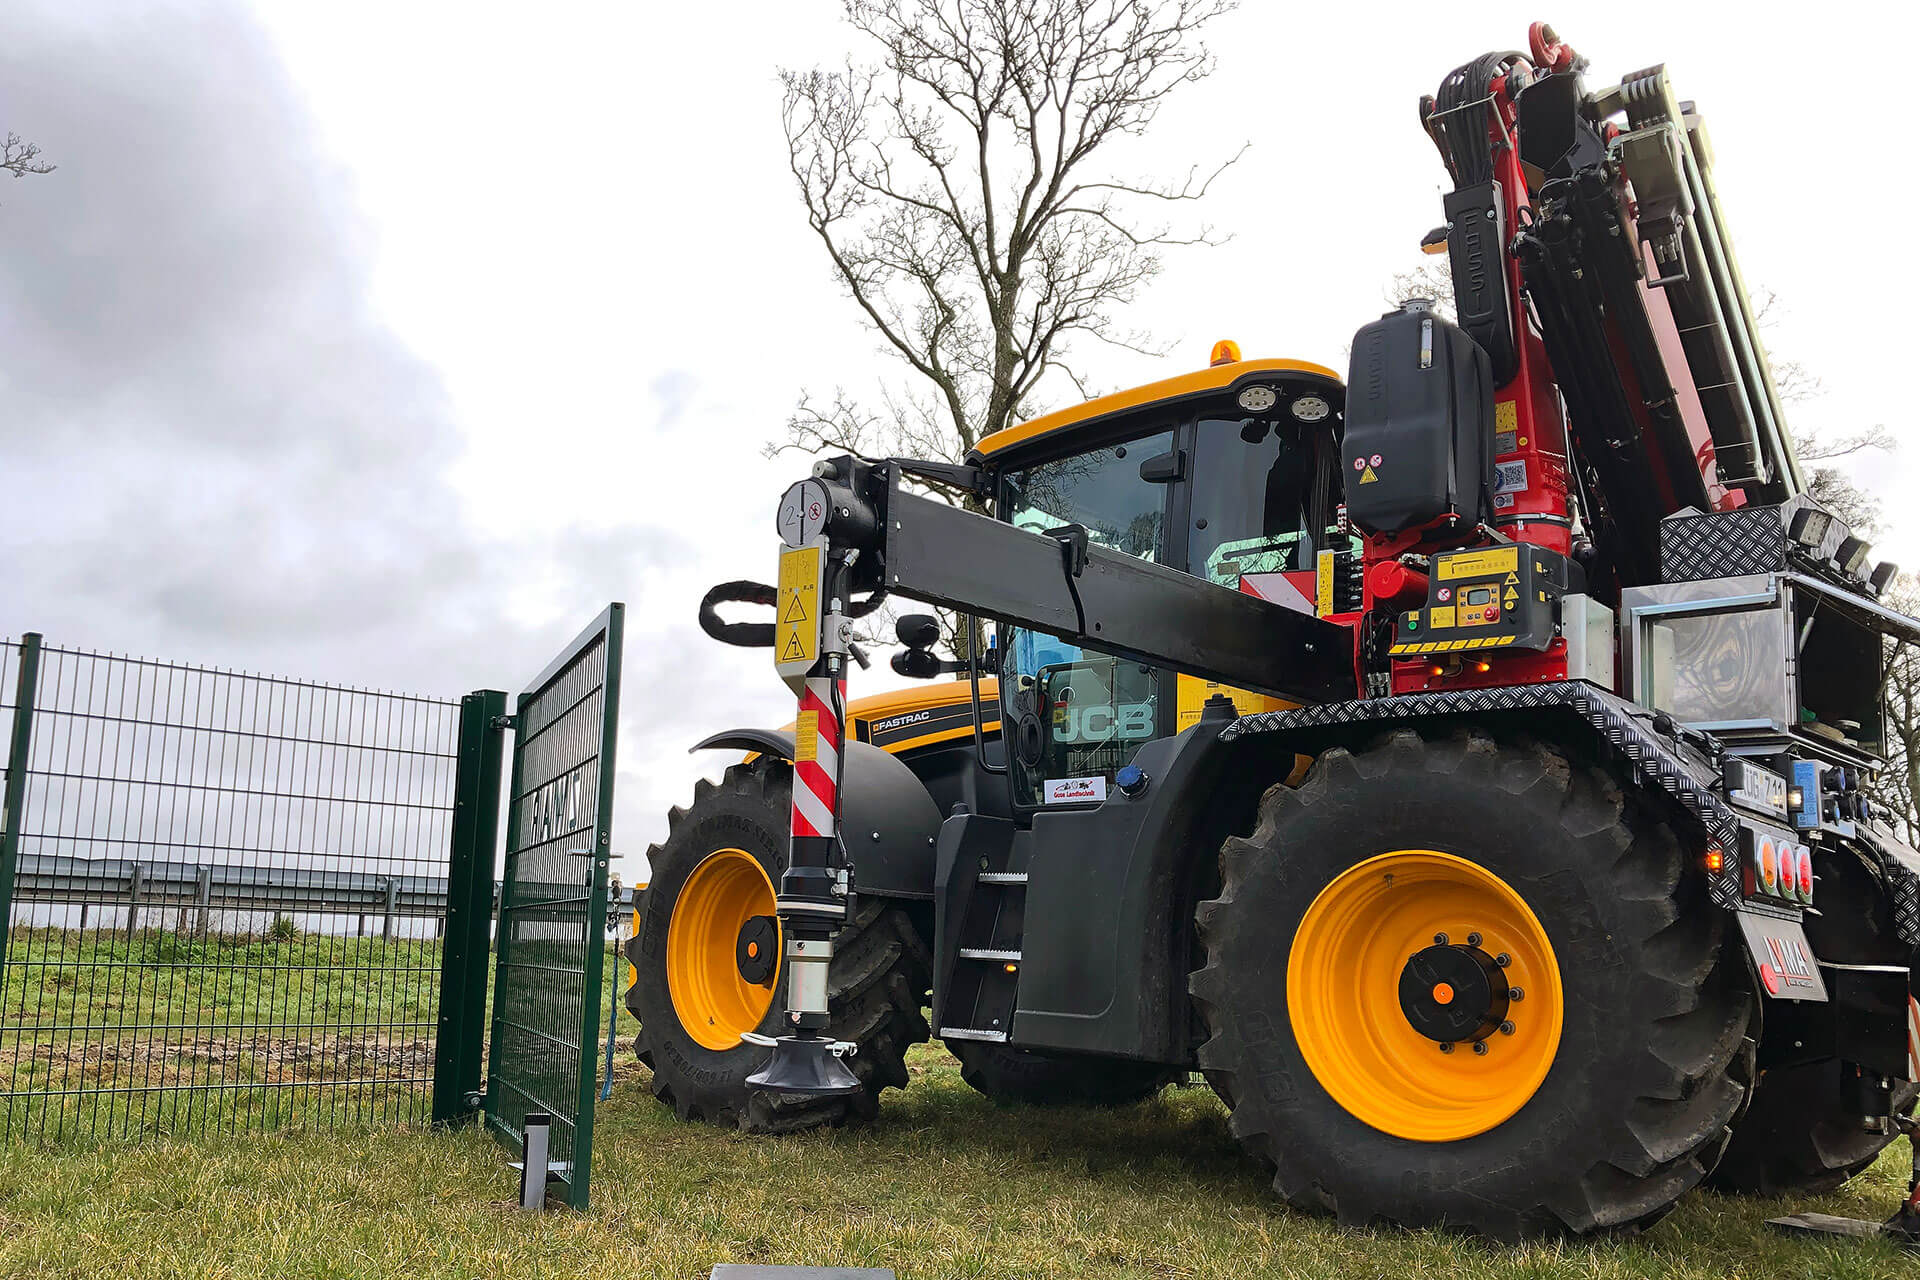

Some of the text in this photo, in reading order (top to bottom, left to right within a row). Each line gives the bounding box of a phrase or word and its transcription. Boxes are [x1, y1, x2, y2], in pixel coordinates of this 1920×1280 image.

[879, 711, 930, 730] FASTRAC
[1053, 703, 1154, 741] JCB
[1762, 935, 1811, 987] LYMA
